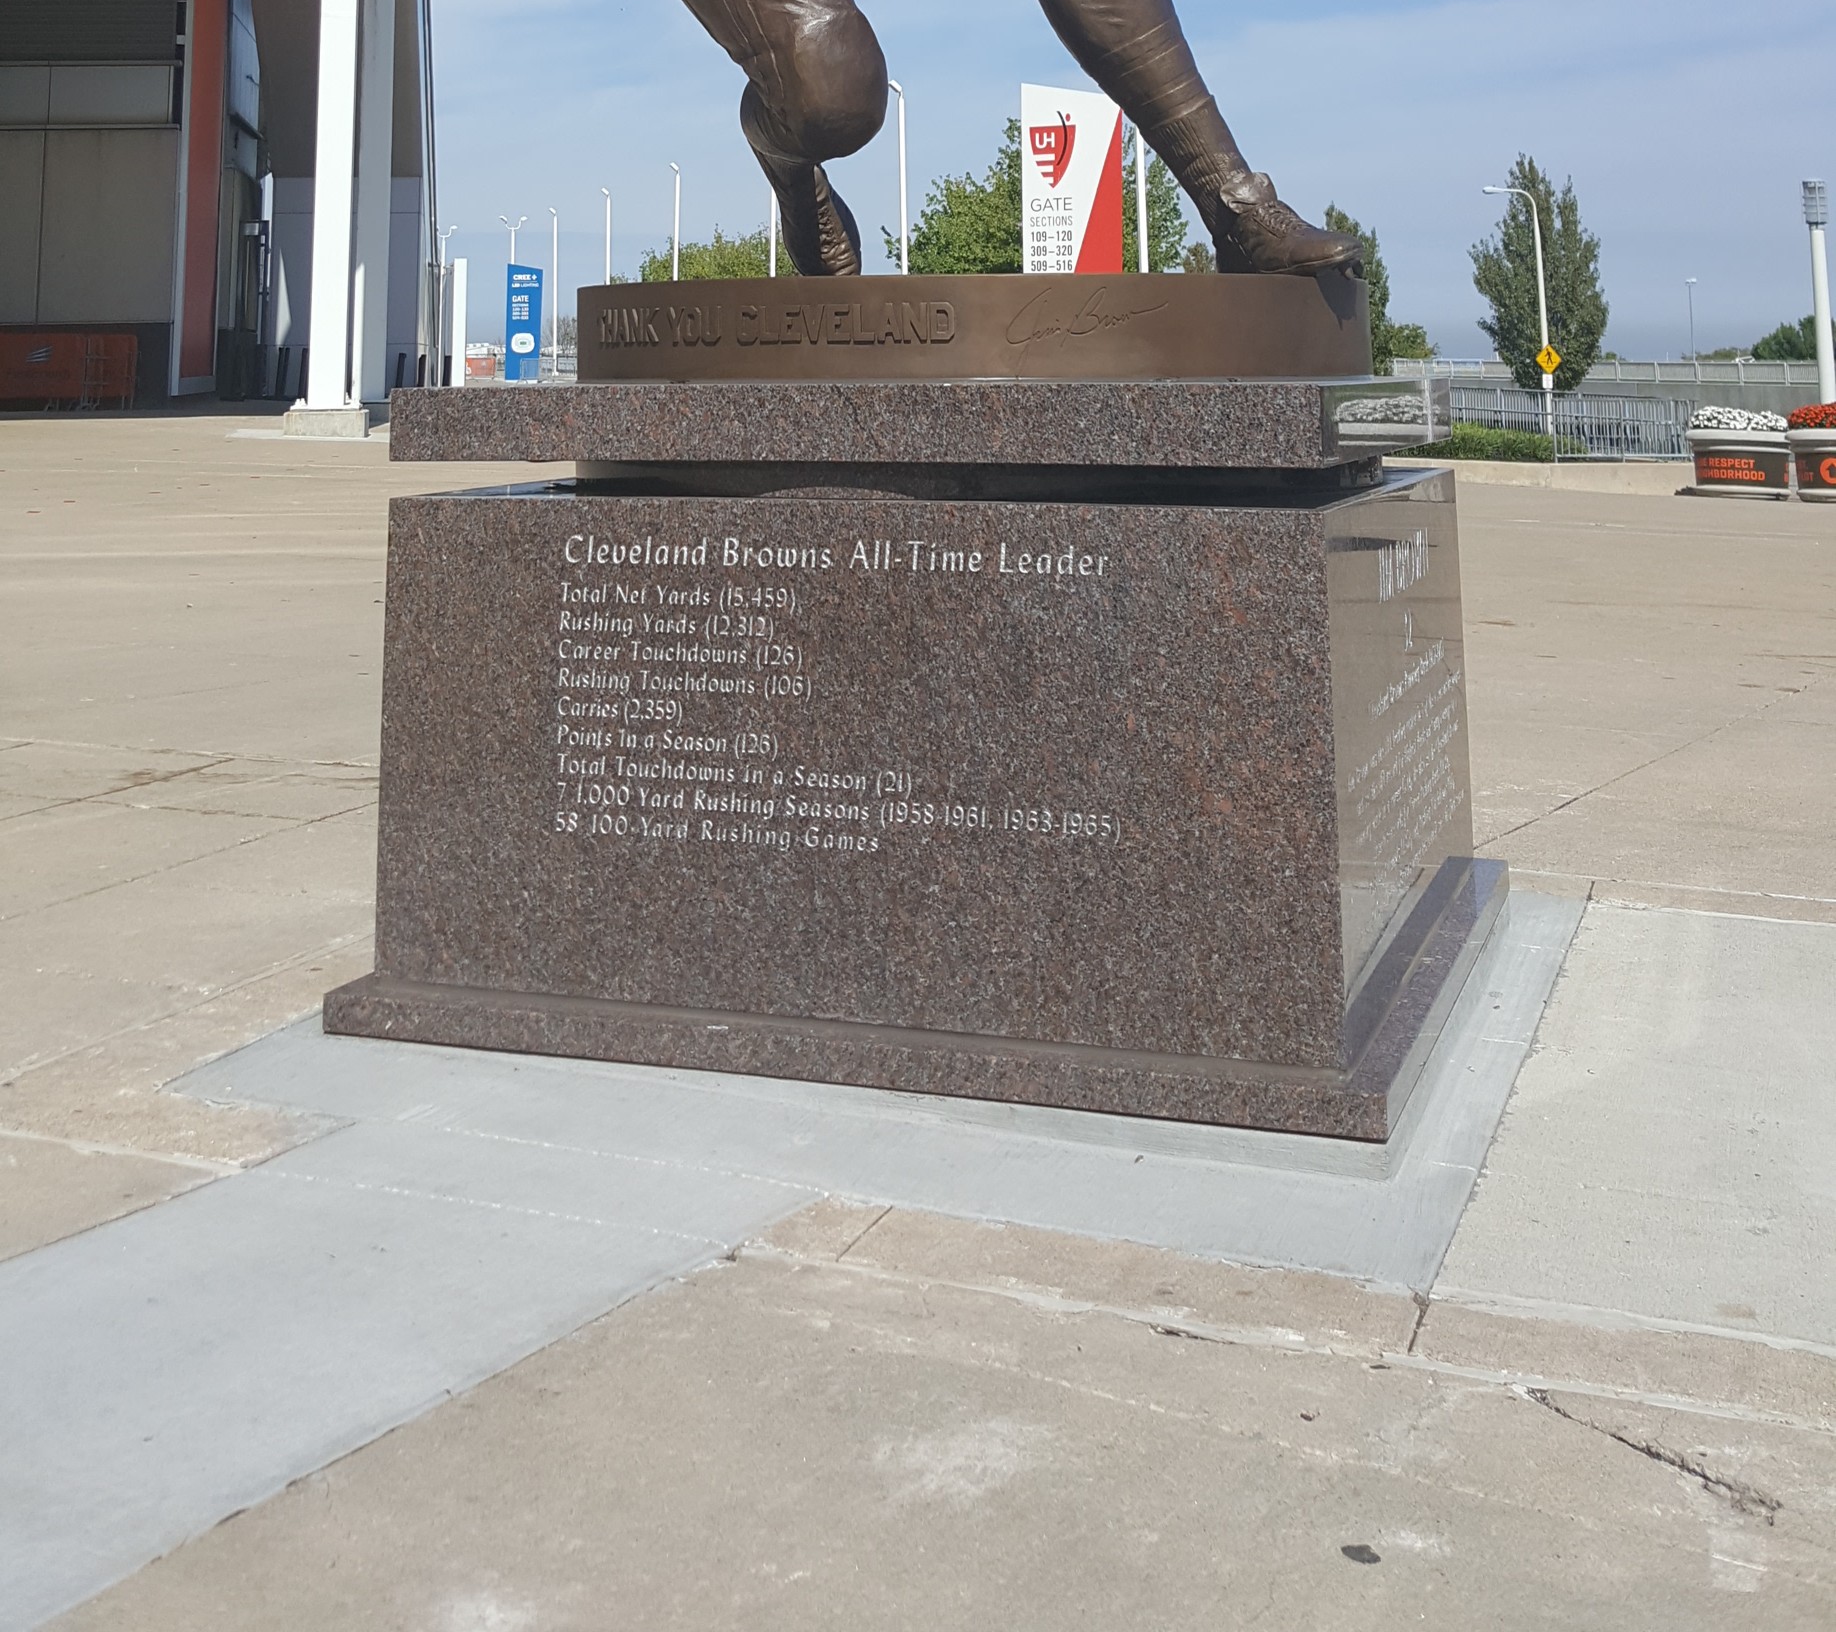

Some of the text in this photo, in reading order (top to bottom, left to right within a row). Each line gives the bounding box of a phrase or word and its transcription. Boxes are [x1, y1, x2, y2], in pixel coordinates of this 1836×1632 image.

[1034, 131, 1056, 150] UH
[1030, 196, 1073, 213] GATE
[1030, 216, 1073, 228] SECTIONS
[512, 295, 529, 303] GATE
[667, 305, 722, 347] YOU
[736, 301, 956, 346] CLEVELAND
[1708, 457, 1755, 469] RESPECT
[565, 535, 1108, 576] Cleveland Browns All-Time Leader
[560, 583, 607, 605] Total
[616, 585, 648, 605] Net
[657, 585, 710, 606] Yards
[560, 611, 633, 637] Rushing
[643, 613, 696, 634] Yards
[558, 639, 802, 672] Career Touchdowns (126)
[558, 668, 812, 702] Rushing Touchdowns (106)
[557, 696, 683, 726] Carries (2,359)
[557, 725, 612, 749] Points
[645, 735, 654, 748] a
[663, 730, 727, 752] Season
[734, 733, 778, 761] (126)
[557, 754, 606, 775] Total
[616, 756, 734, 782] Touchdowns
[774, 770, 783, 784] a
[795, 766, 866, 790] Season
[876, 771, 912, 799] (21)
[557, 782, 566, 803] 7
[577, 781, 630, 806] 1,000
[640, 786, 684, 809] Yard
[694, 790, 774, 819] Rushing
[786, 795, 869, 821] Seasons
[1003, 804, 1121, 844] 1963-1965)
[556, 812, 879, 852] 58 100 Yard Rushing Games
